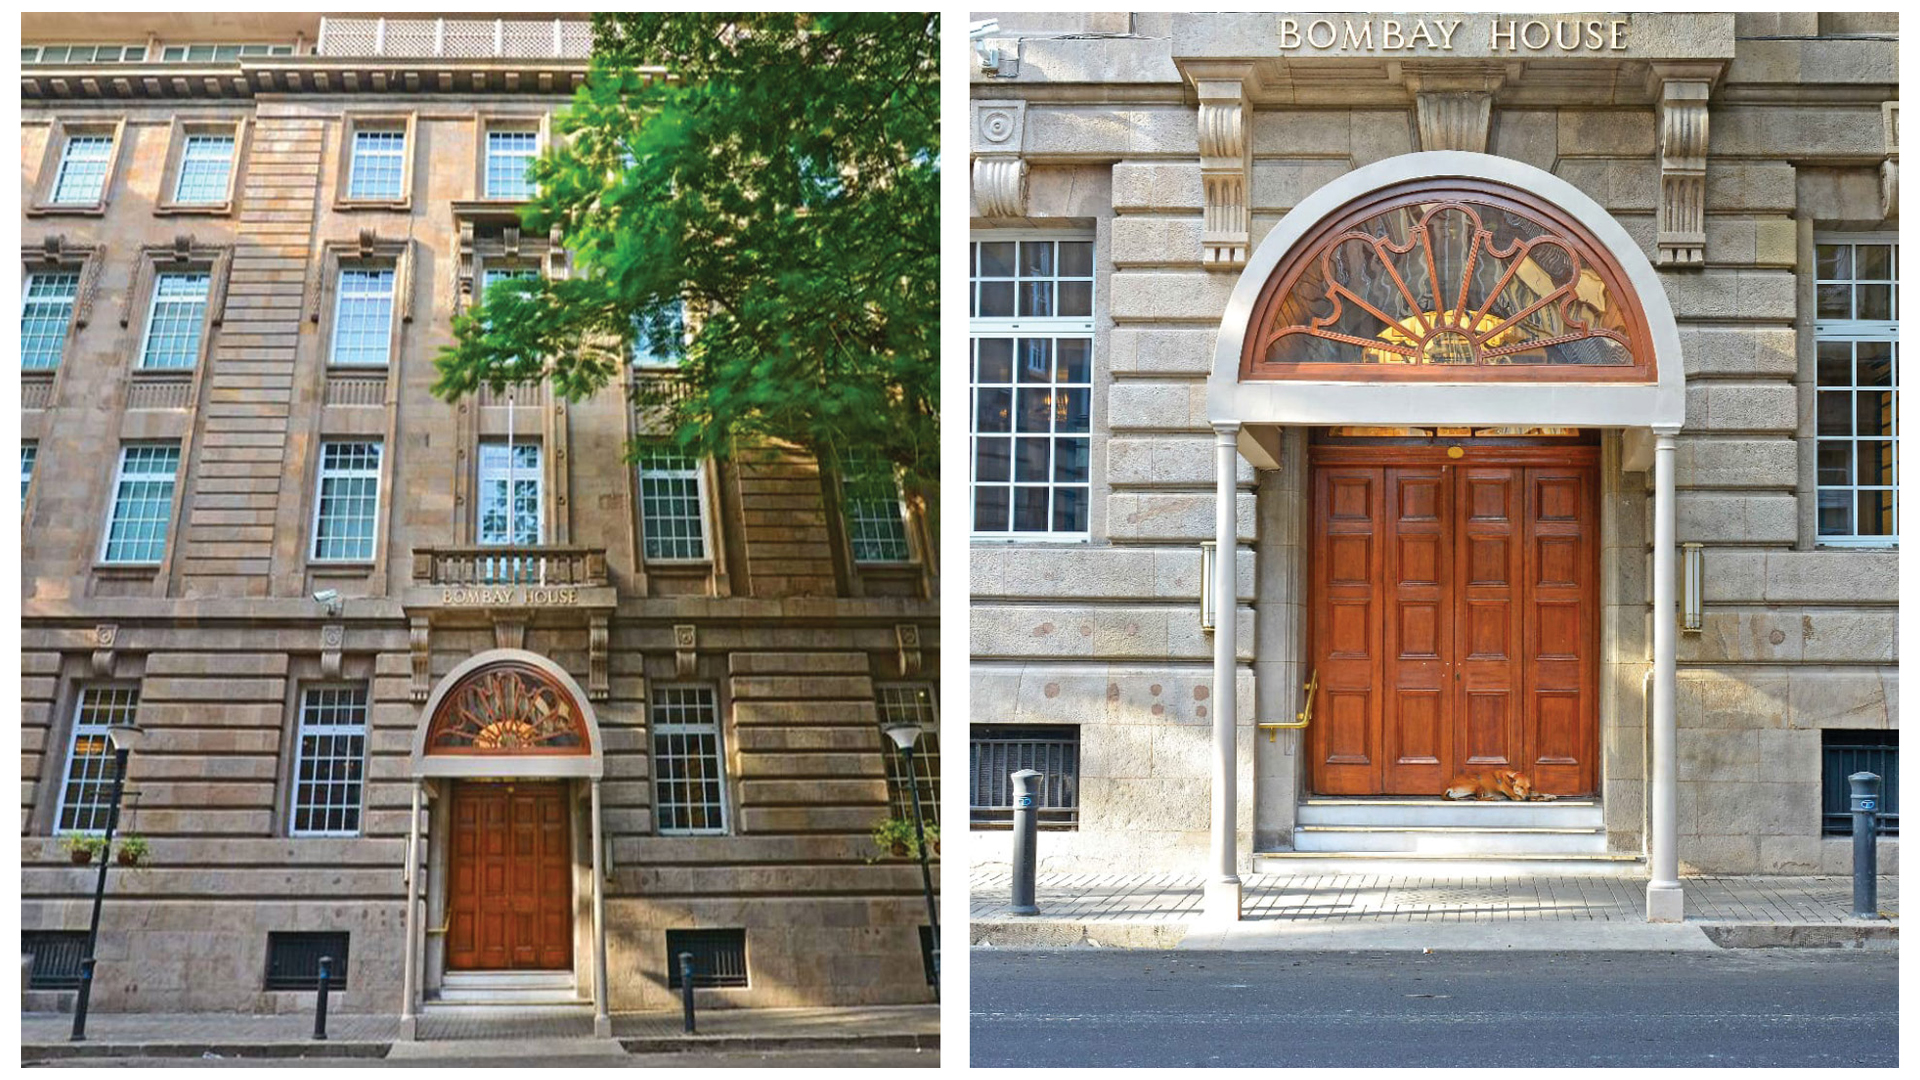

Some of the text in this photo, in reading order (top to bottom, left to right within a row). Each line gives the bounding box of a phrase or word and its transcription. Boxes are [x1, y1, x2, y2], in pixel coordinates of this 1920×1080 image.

[1278, 18, 1628, 51] BOMBAY HOUSE
[442, 589, 578, 605] BOMBAY HOUSE
